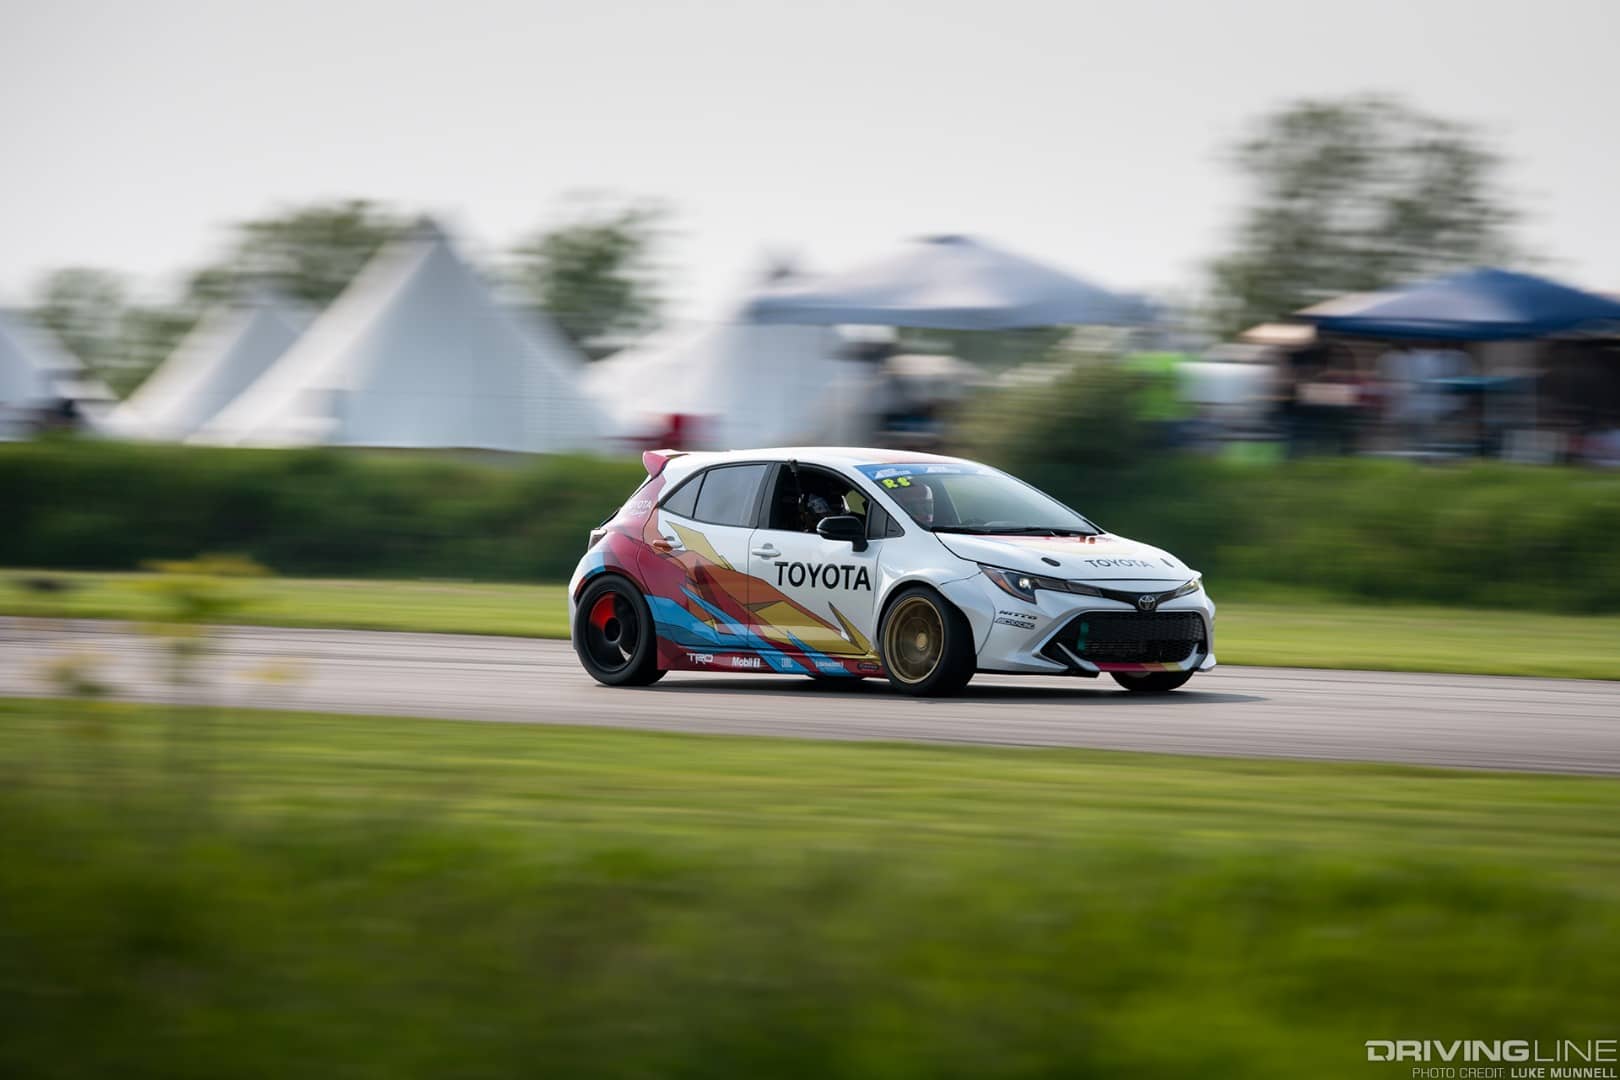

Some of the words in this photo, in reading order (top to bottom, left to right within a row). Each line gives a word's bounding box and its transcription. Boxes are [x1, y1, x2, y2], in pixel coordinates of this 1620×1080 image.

[1084, 559, 1155, 569] TOYOTA
[774, 561, 872, 591] TOYOTA
[686, 652, 714, 665] TRD
